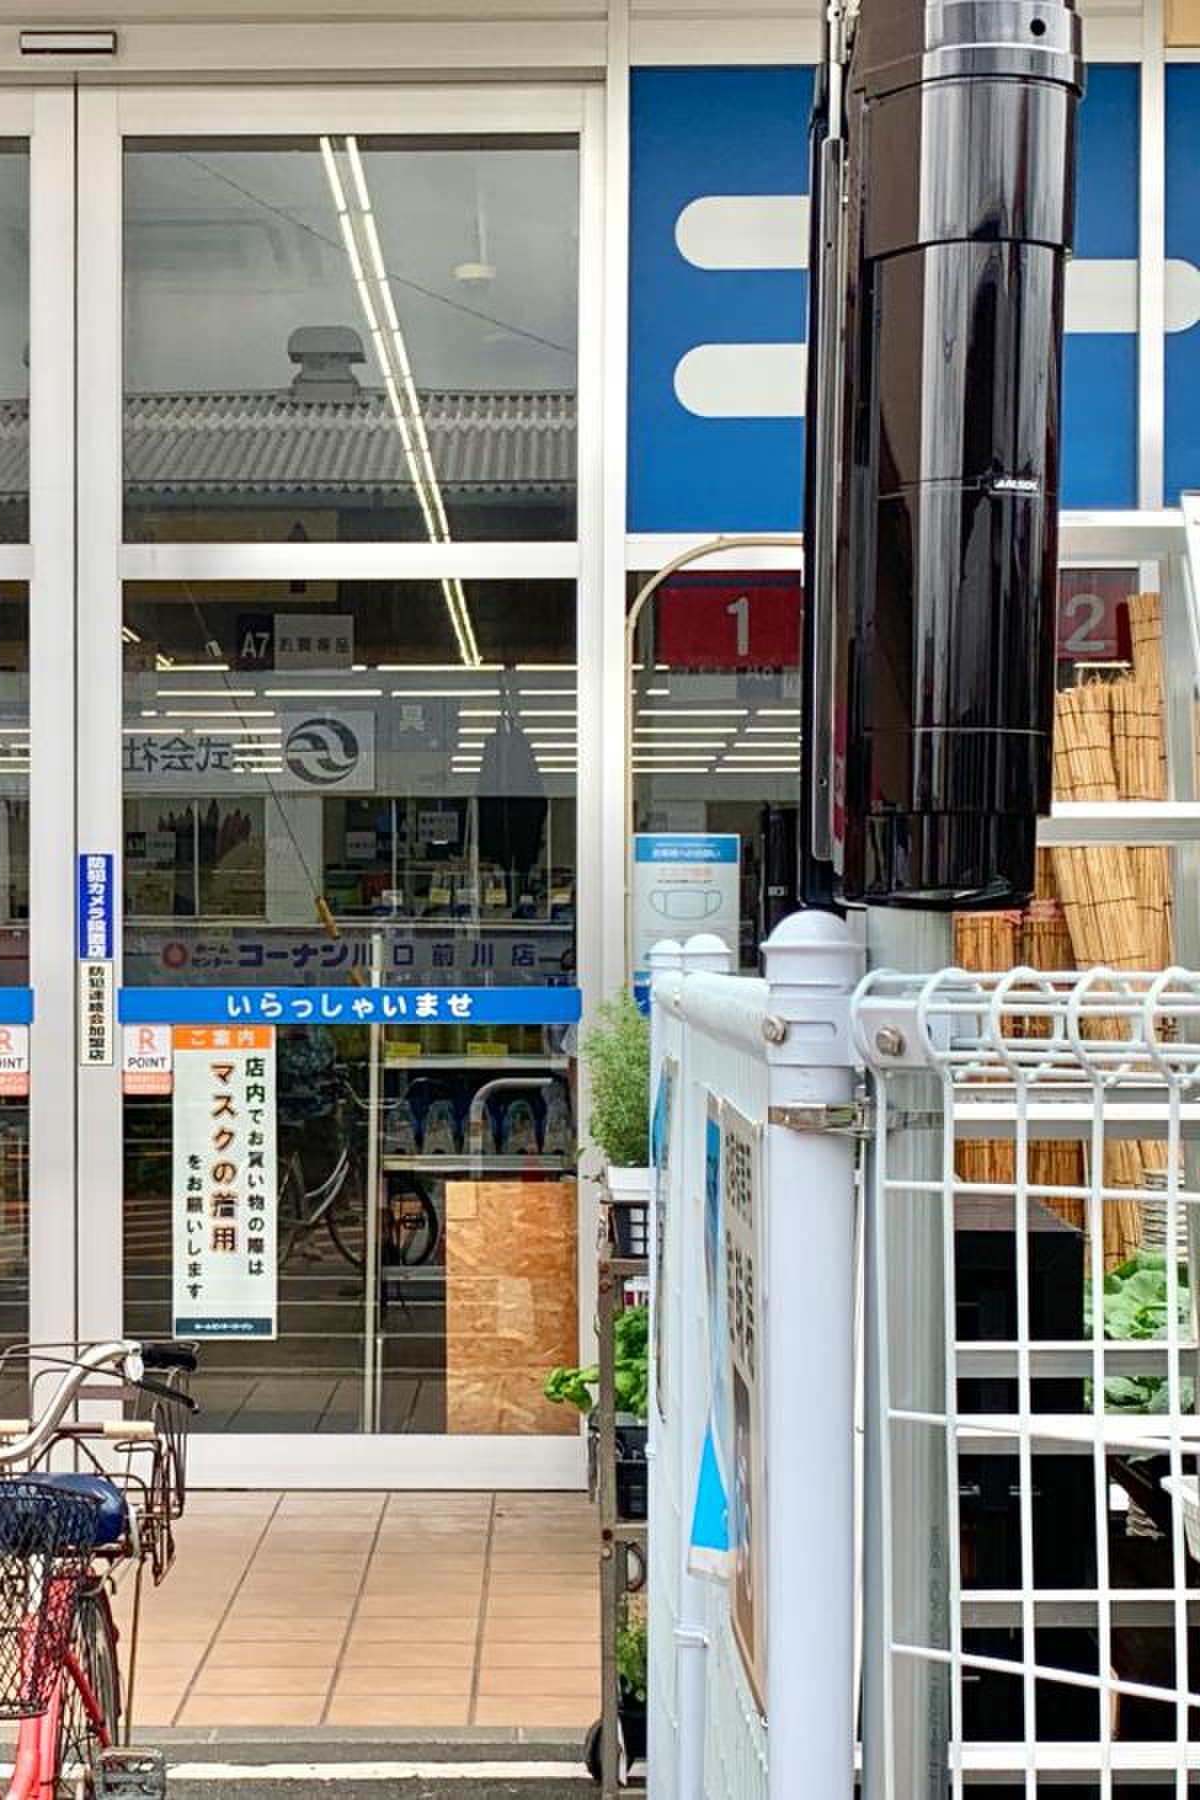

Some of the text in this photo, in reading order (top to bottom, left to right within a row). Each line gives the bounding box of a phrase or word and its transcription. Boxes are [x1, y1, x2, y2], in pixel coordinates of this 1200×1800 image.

[726, 597, 749, 656] 1
[1063, 592, 1106, 652] 2
[241, 631, 271, 659] A7
[226, 992, 474, 1019] いらっしゃいませ
[139, 1028, 157, 1050] R
[191, 1030, 257, 1047] ご案内
[127, 1056, 166, 1069] POINT
[210, 1062, 238, 1253] マスクの着用
[245, 1057, 266, 1277] 店内でお買い物の際は
[186, 1154, 204, 1299] をお願いします
